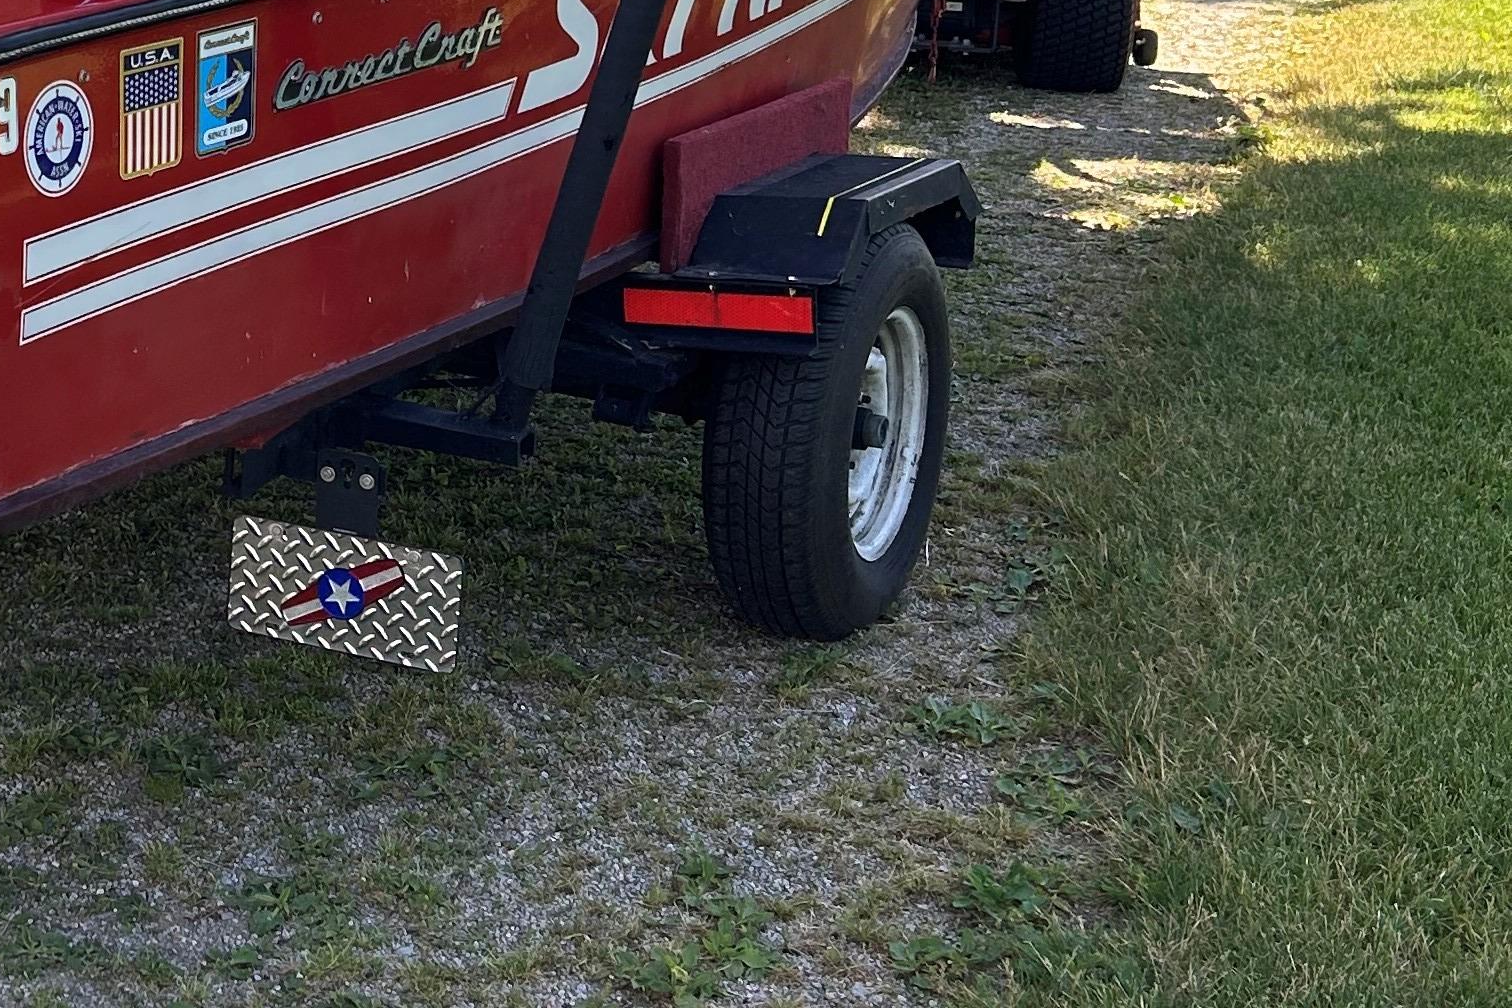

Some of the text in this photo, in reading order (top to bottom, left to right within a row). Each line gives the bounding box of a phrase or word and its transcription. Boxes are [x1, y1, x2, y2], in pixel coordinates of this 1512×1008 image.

[130, 47, 175, 68] U.S.A.
[275, 6, 503, 110] Correct Craft
